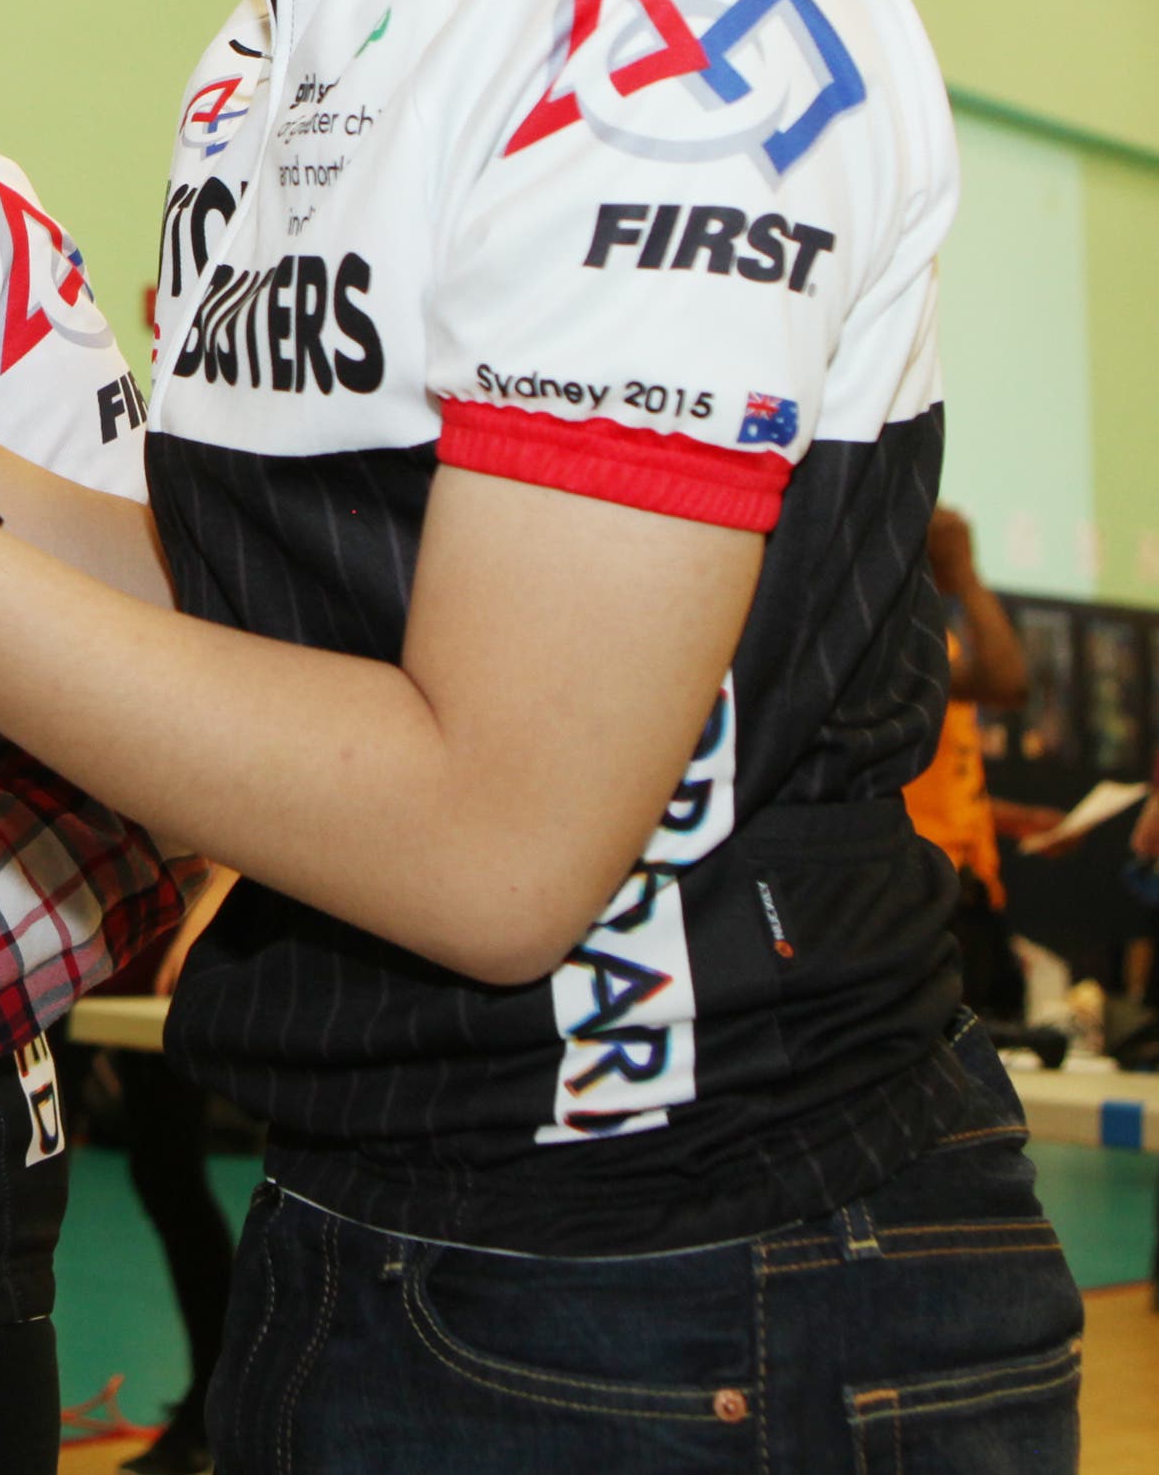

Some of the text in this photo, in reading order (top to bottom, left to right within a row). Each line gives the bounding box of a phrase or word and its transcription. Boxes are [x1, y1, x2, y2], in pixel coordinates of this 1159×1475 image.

[583, 203, 835, 294] FIRST
[476, 364, 714, 419] Sydney 2015
